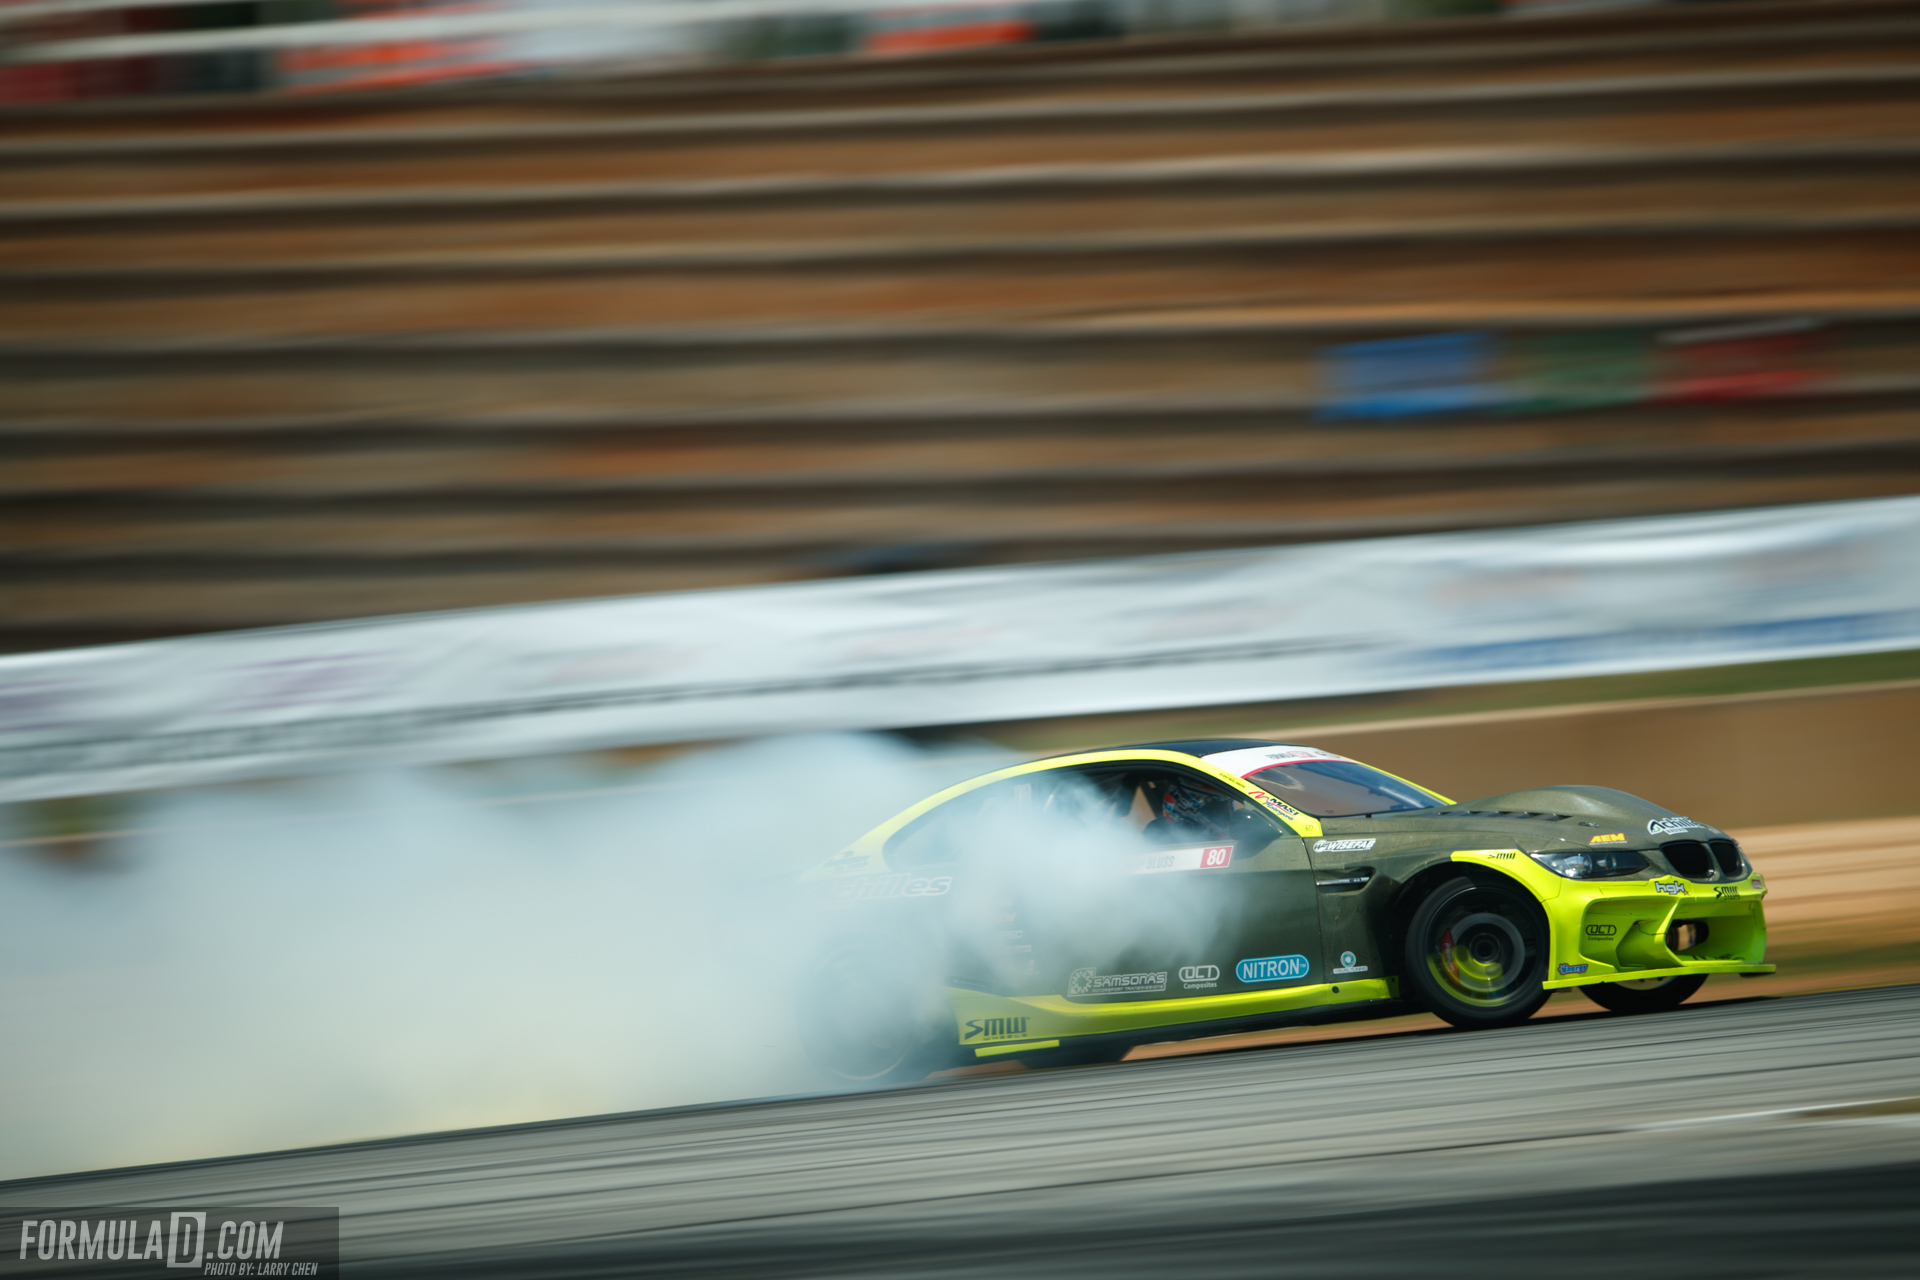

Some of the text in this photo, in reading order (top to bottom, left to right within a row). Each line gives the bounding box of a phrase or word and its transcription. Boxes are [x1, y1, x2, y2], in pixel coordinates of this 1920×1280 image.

[1328, 838, 1376, 850] WISEFAB
[1590, 833, 1626, 843] AEM
[1146, 855, 1175, 870] BLUSS
[1206, 849, 1228, 867] 80
[1243, 958, 1300, 980] NITRON
[1093, 973, 1166, 988] SAMSONAS
[1183, 982, 1218, 990] Composites
